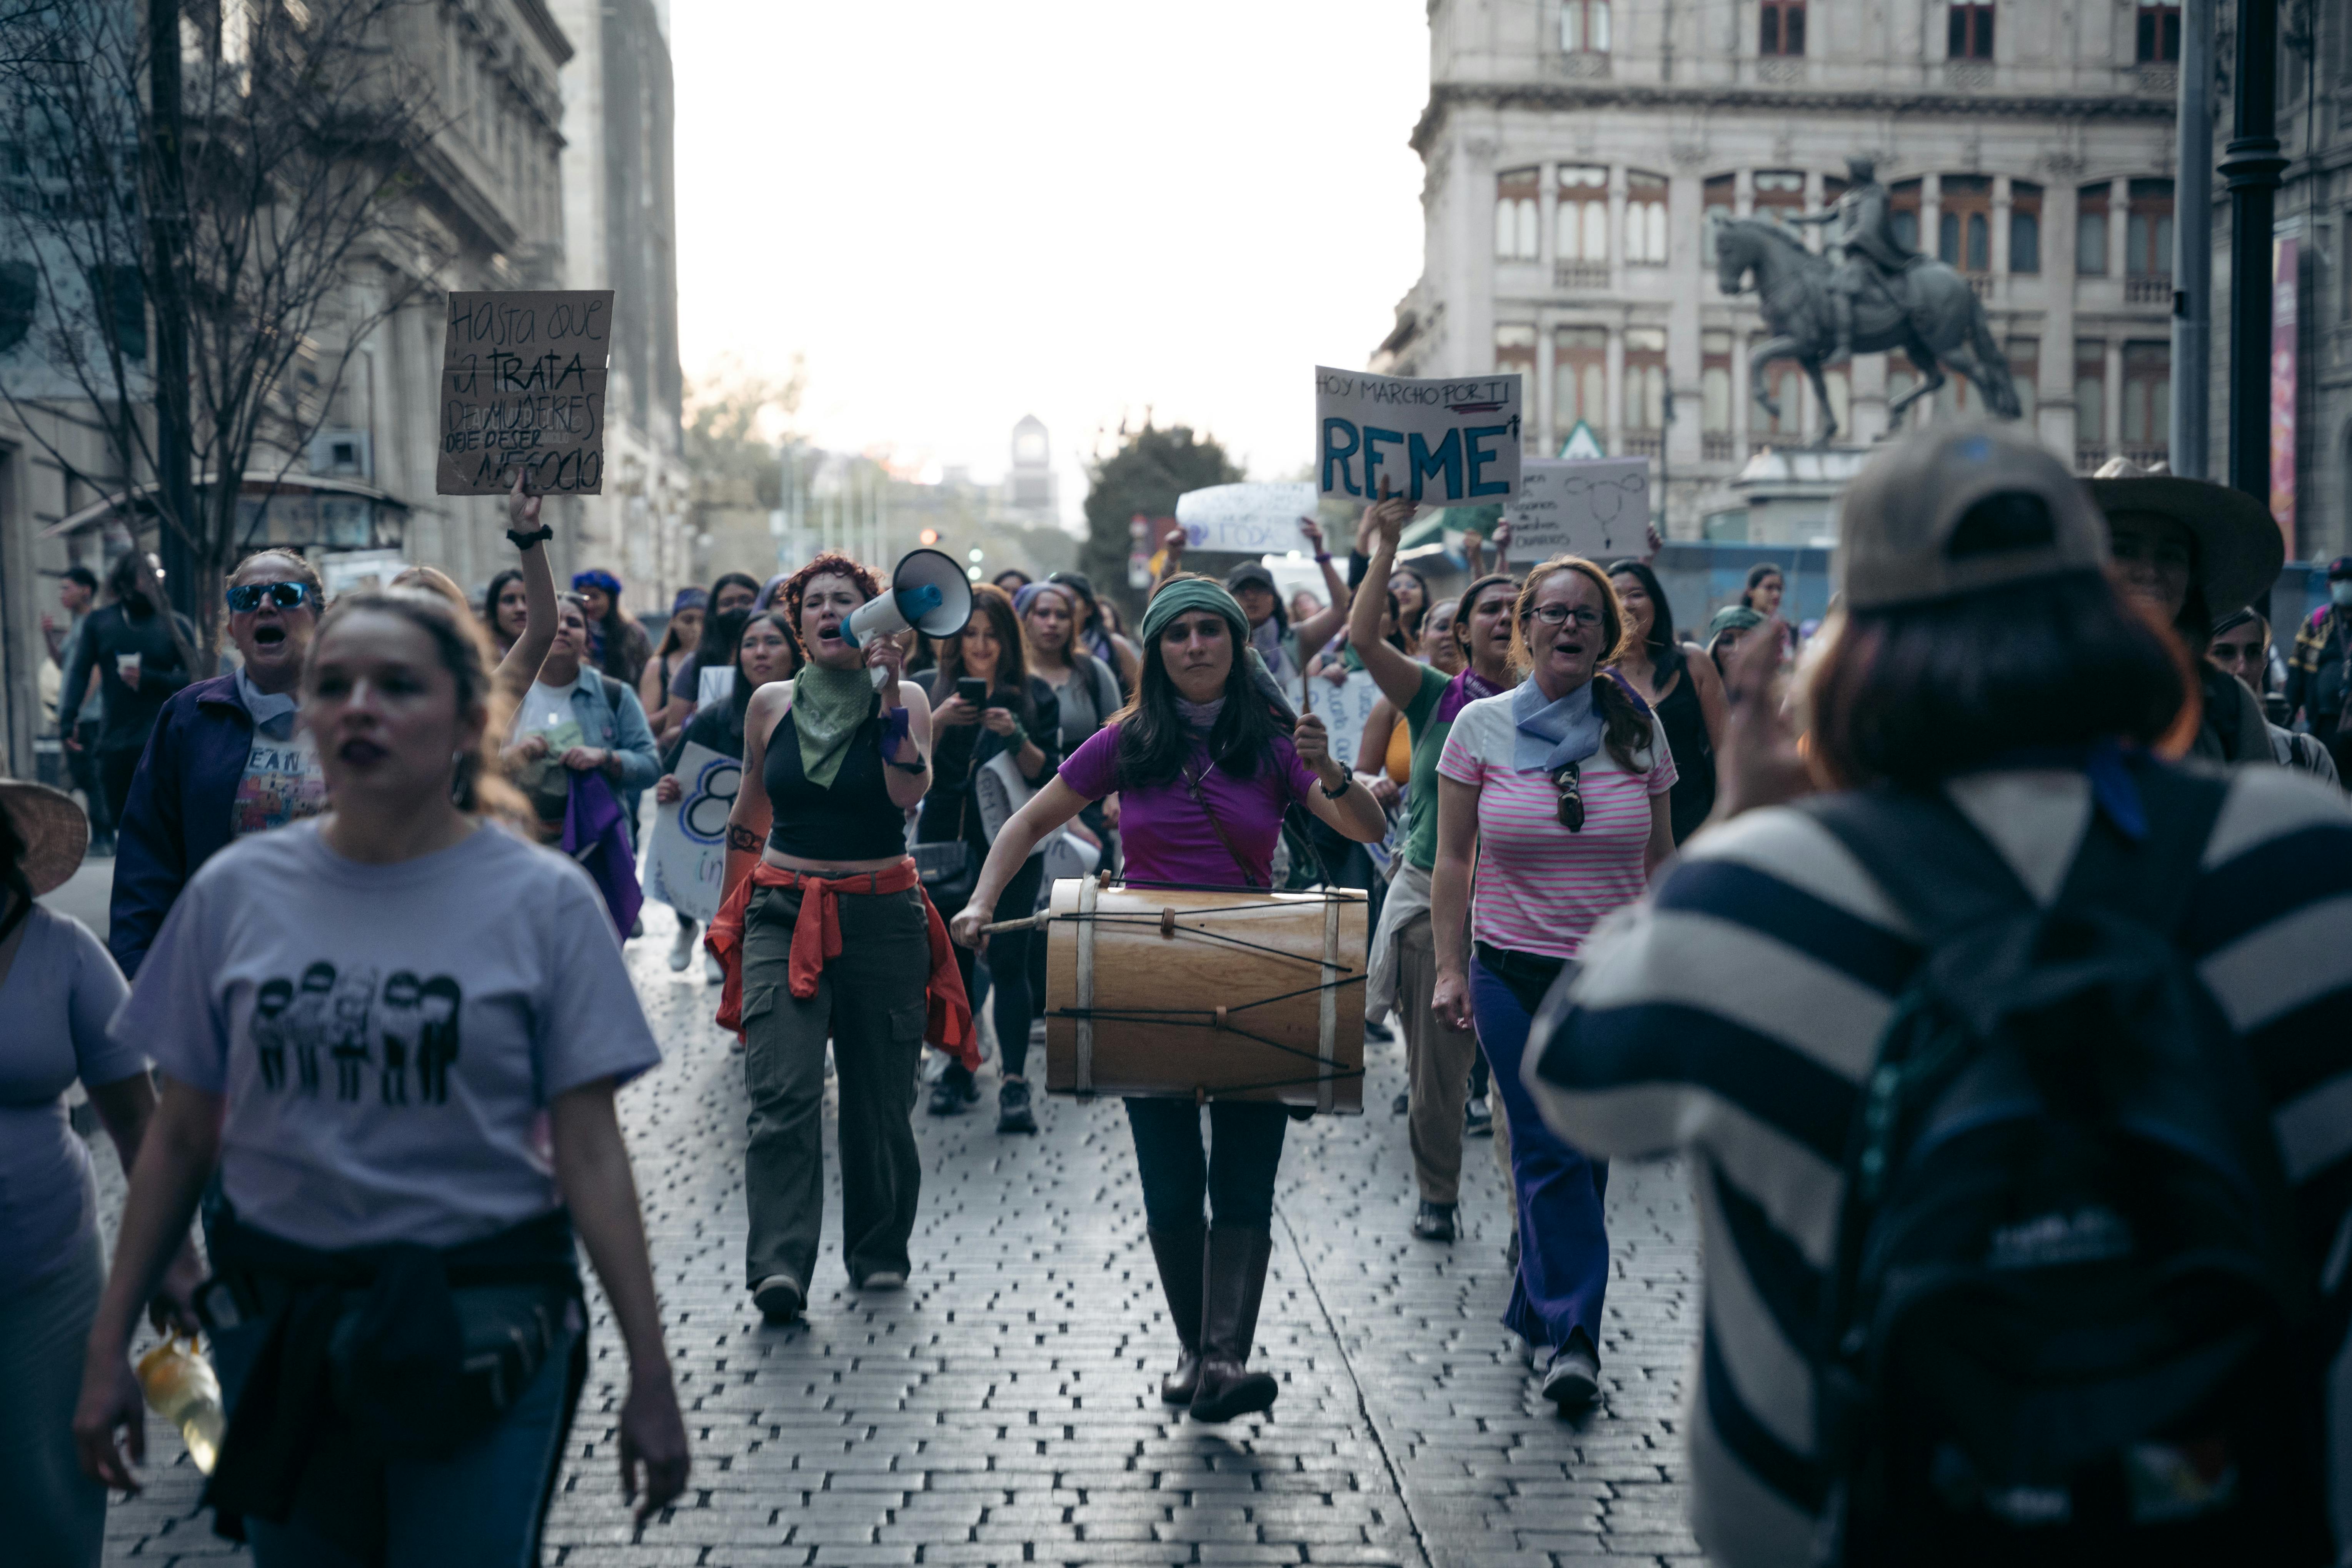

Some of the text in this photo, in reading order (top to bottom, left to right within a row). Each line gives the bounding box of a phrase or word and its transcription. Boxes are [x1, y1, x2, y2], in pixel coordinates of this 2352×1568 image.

[486, 347, 586, 394] TRATA
[1316, 375, 1354, 395] HOY
[1360, 382, 1439, 405] MARCHO
[1323, 417, 1510, 500] REME
